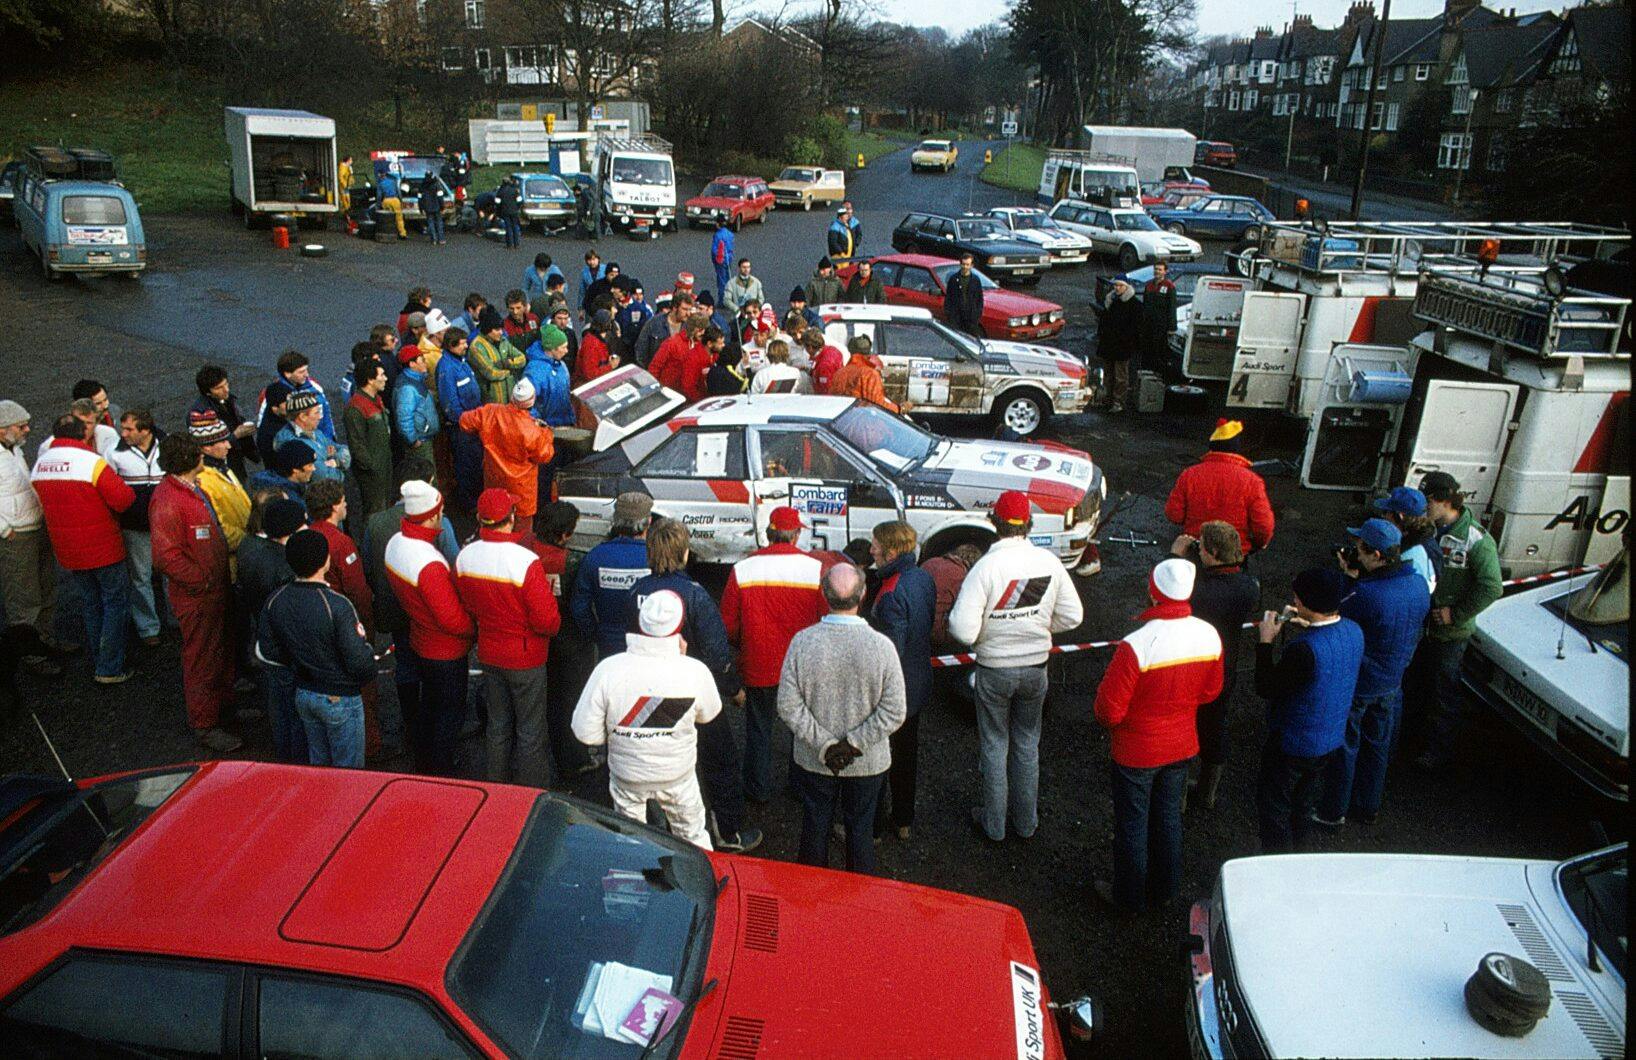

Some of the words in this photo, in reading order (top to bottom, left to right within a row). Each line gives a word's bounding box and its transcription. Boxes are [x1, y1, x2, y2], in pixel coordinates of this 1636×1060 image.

[1241, 361, 1260, 369] Audi
[1261, 362, 1285, 371] Sport
[925, 382, 933, 403] 1
[1231, 373, 1250, 402] 4
[37, 461, 70, 472] PIRELLI
[791, 486, 848, 500] Lombard
[682, 514, 715, 525] Castrol
[811, 518, 829, 551] 5
[1008, 611, 1030, 620] Sport
[613, 729, 631, 738] Audi
[632, 731, 660, 739] Sport
[1021, 986, 1036, 1009] UK
[1025, 1009, 1042, 1053] Sport
